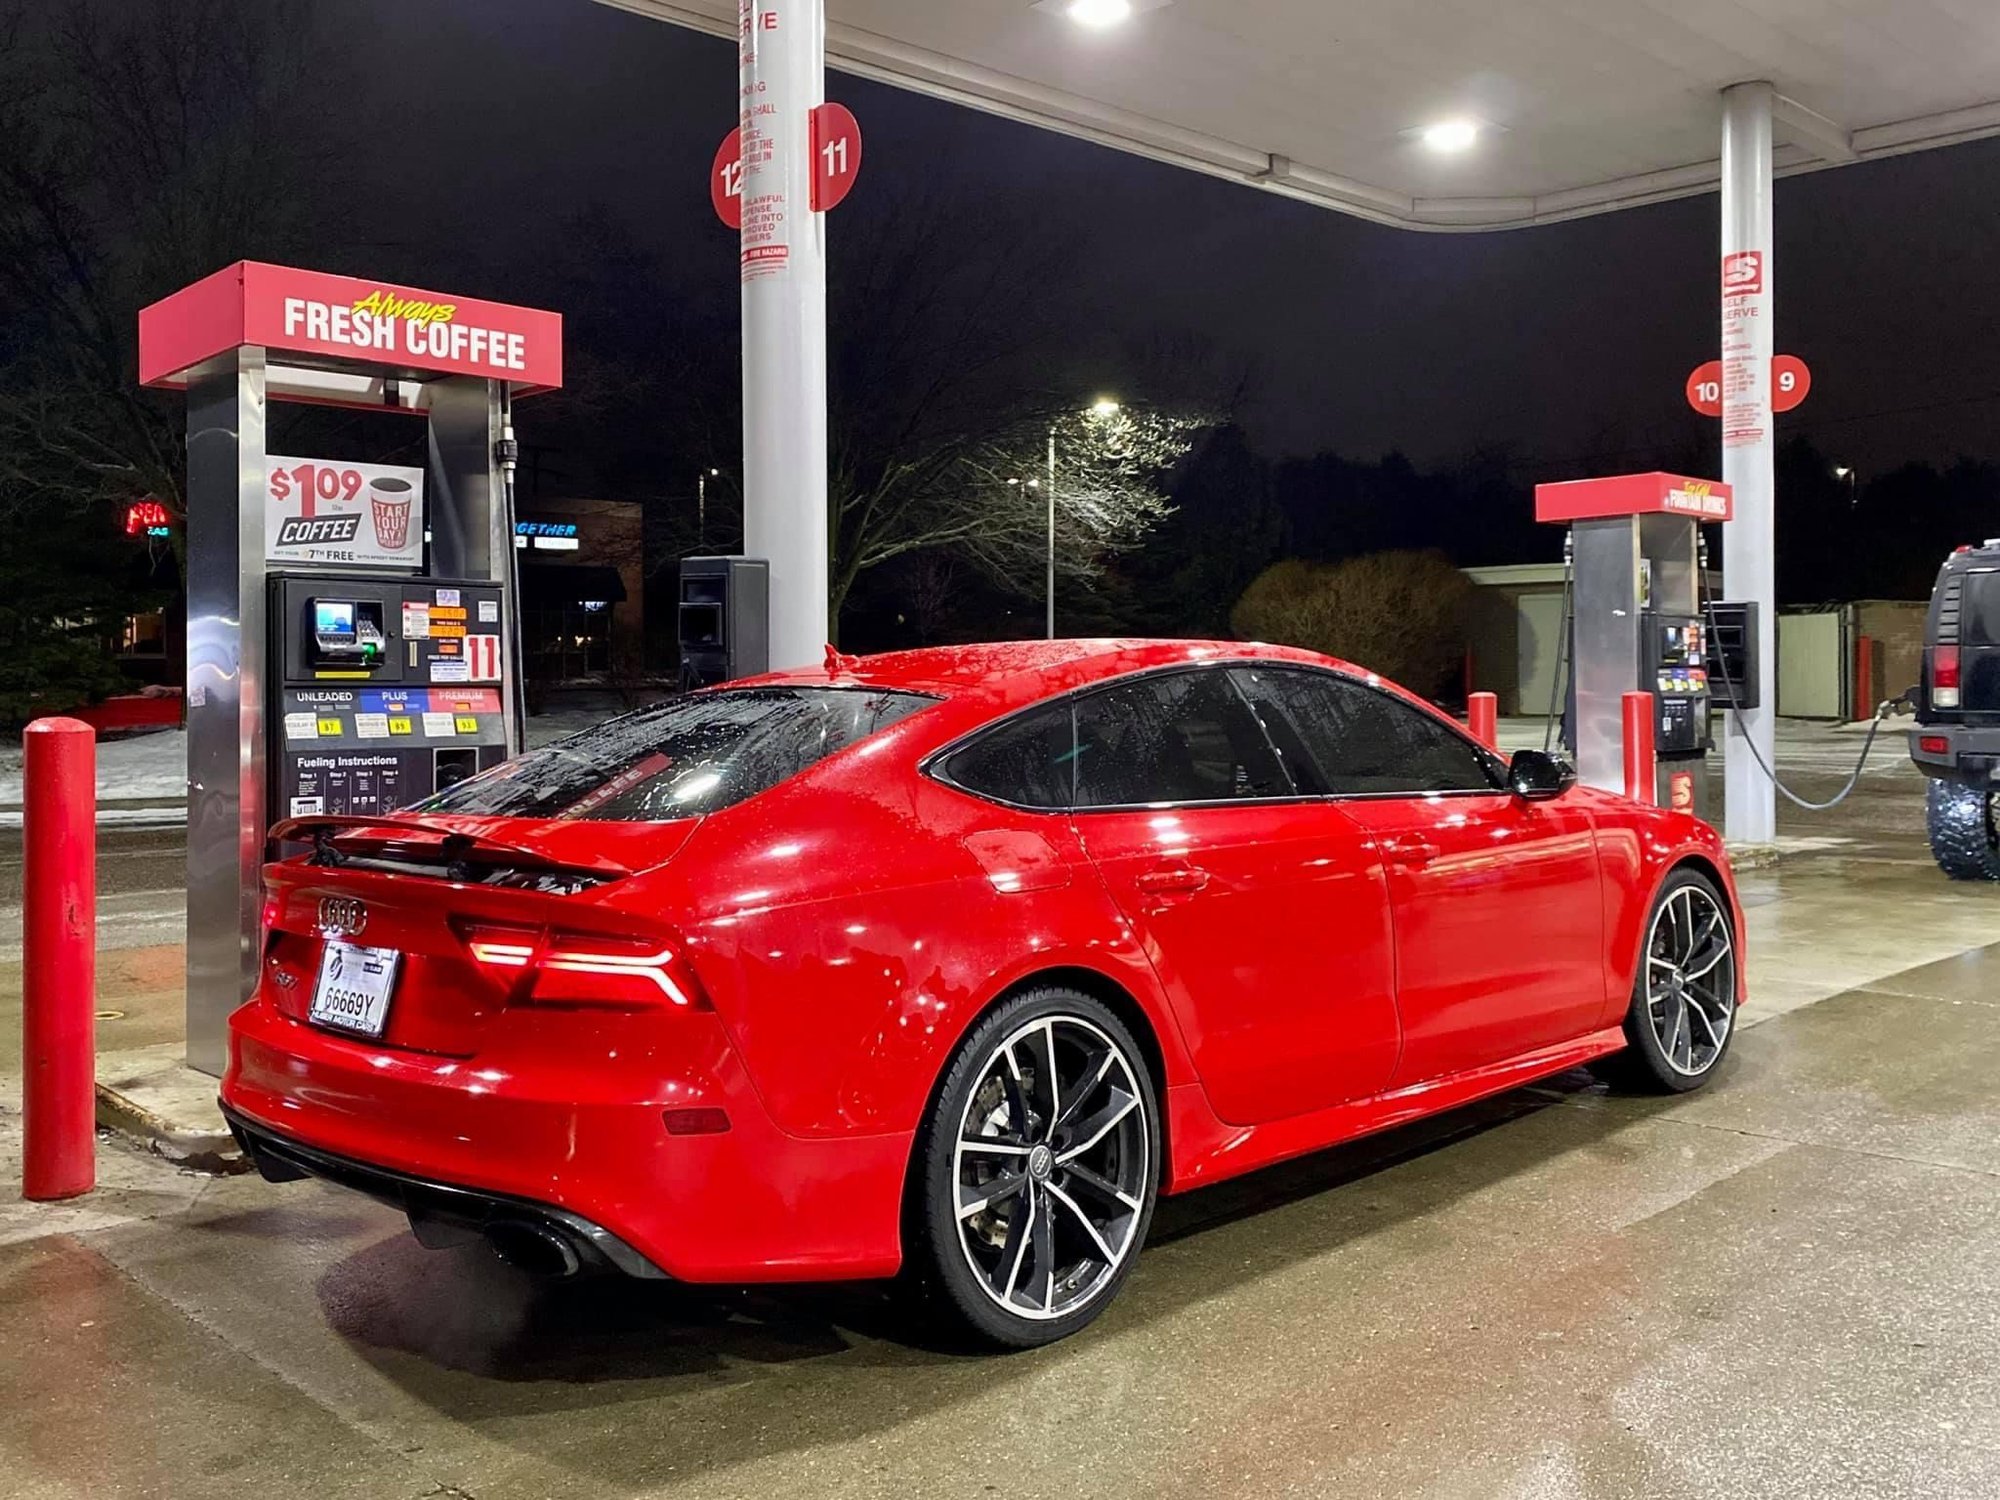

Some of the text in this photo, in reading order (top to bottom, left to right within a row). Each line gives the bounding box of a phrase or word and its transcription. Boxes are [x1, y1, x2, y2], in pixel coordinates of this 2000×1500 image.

[822, 137, 848, 177] 11
[720, 160, 742, 198] 12
[353, 290, 457, 329] Always
[284, 297, 525, 370] FRESH COFFEE
[1779, 371, 1795, 391] 9
[1695, 382, 1719, 402] 10
[373, 501, 409, 517] START
[282, 519, 357, 543] COFFEE
[375, 515, 406, 529] YOUR
[515, 522, 577, 536] GETHER
[326, 550, 354, 561] FREE
[468, 637, 495, 678] 11
[297, 692, 353, 701] UNLEADED
[382, 691, 408, 701] PLUS
[439, 692, 484, 700] PREMIUM
[297, 755, 398, 769] Fueling Instructions
